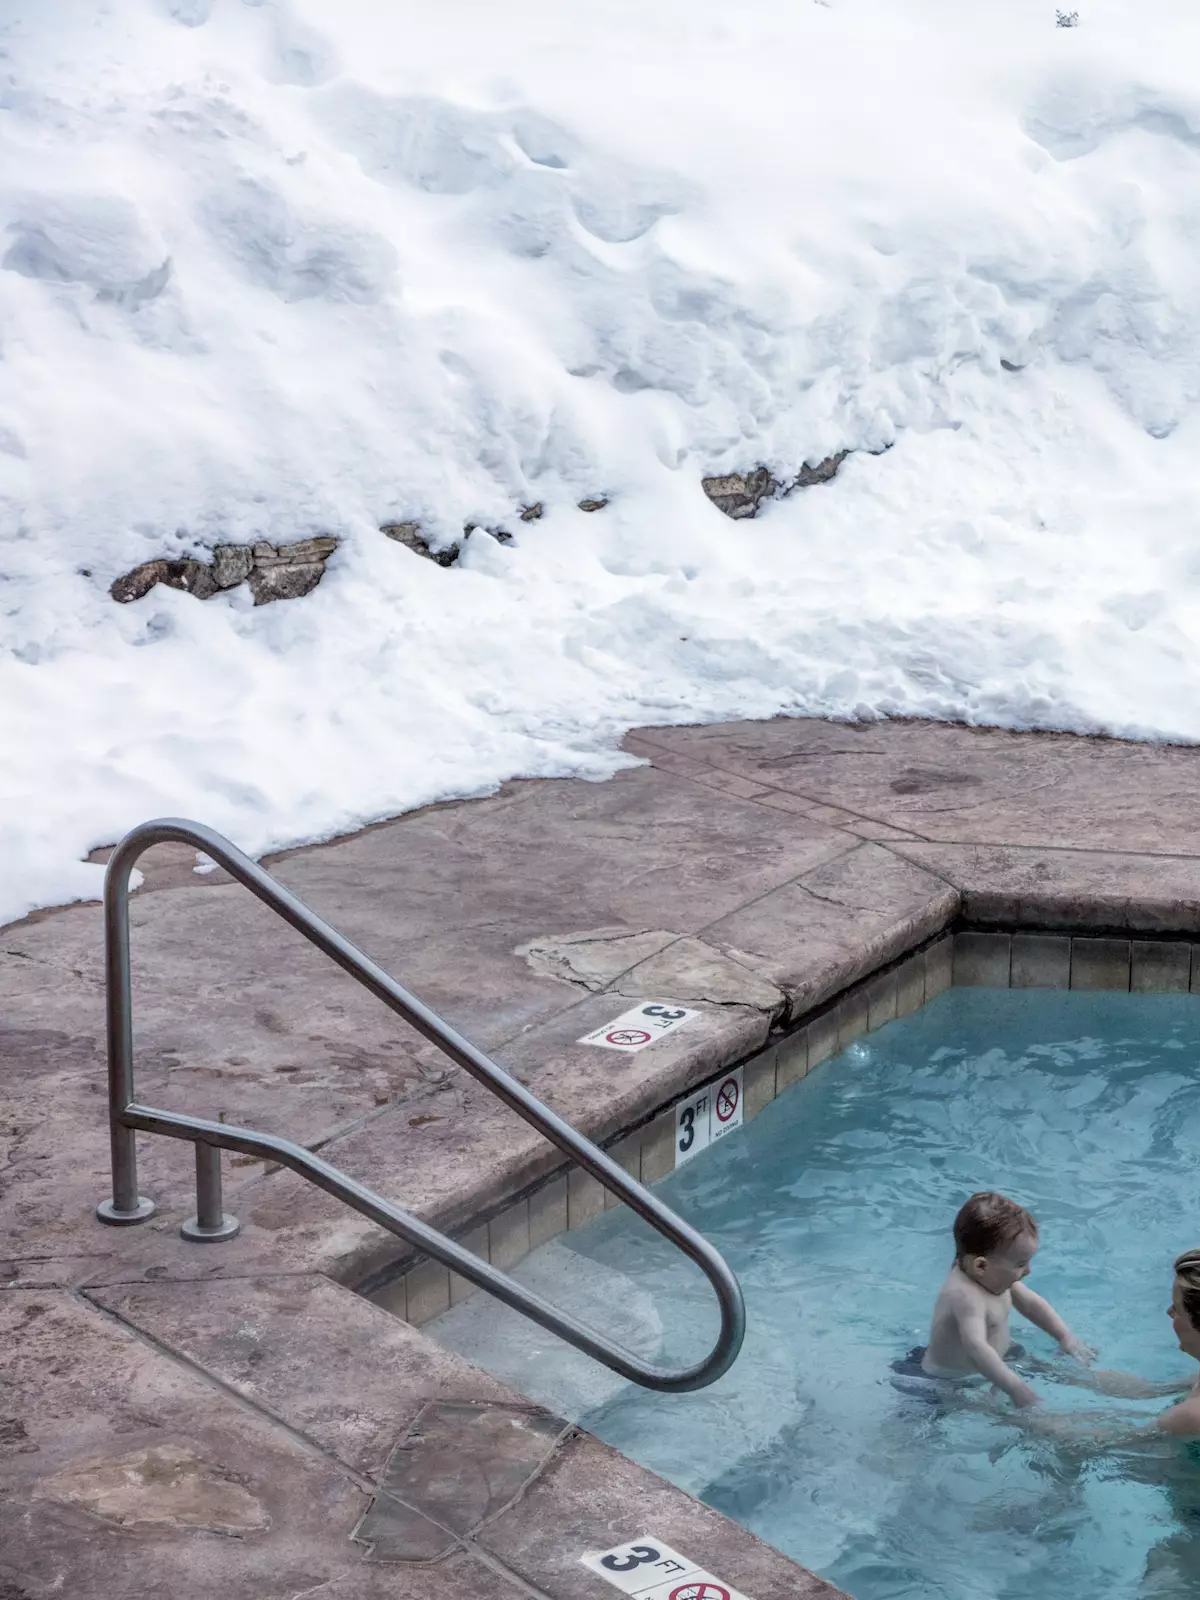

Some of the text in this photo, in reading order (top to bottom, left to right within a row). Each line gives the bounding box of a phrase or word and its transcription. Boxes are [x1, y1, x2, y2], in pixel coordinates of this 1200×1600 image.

[642, 1006, 686, 1028] 3 FT
[679, 1096, 709, 1152] 3 FT
[601, 1546, 686, 1574] 3 FT
